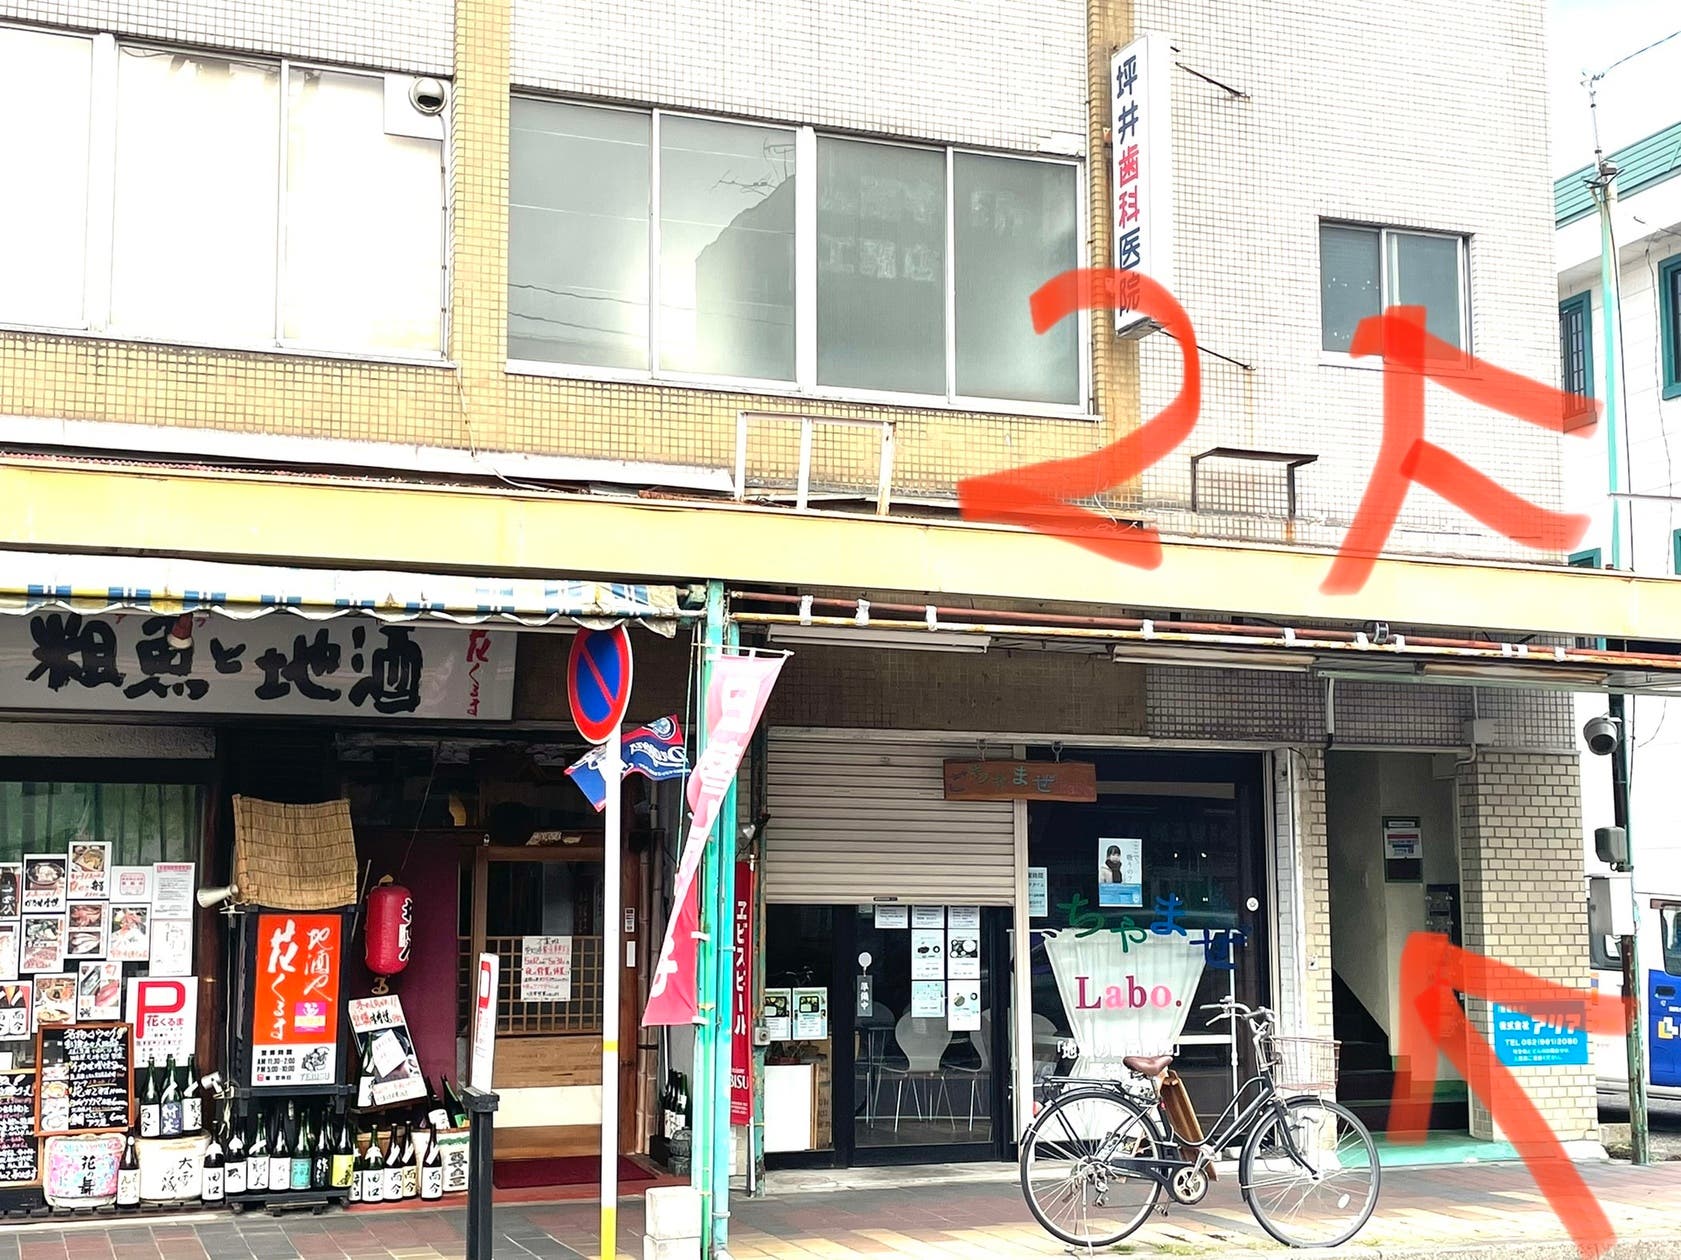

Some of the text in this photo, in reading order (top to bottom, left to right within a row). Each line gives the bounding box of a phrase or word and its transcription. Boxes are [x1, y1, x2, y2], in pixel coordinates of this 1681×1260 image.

[1116, 54, 1140, 316] 坪井歯科医院
[136, 981, 186, 1039] P
[1076, 976, 1182, 1010] Labo.
